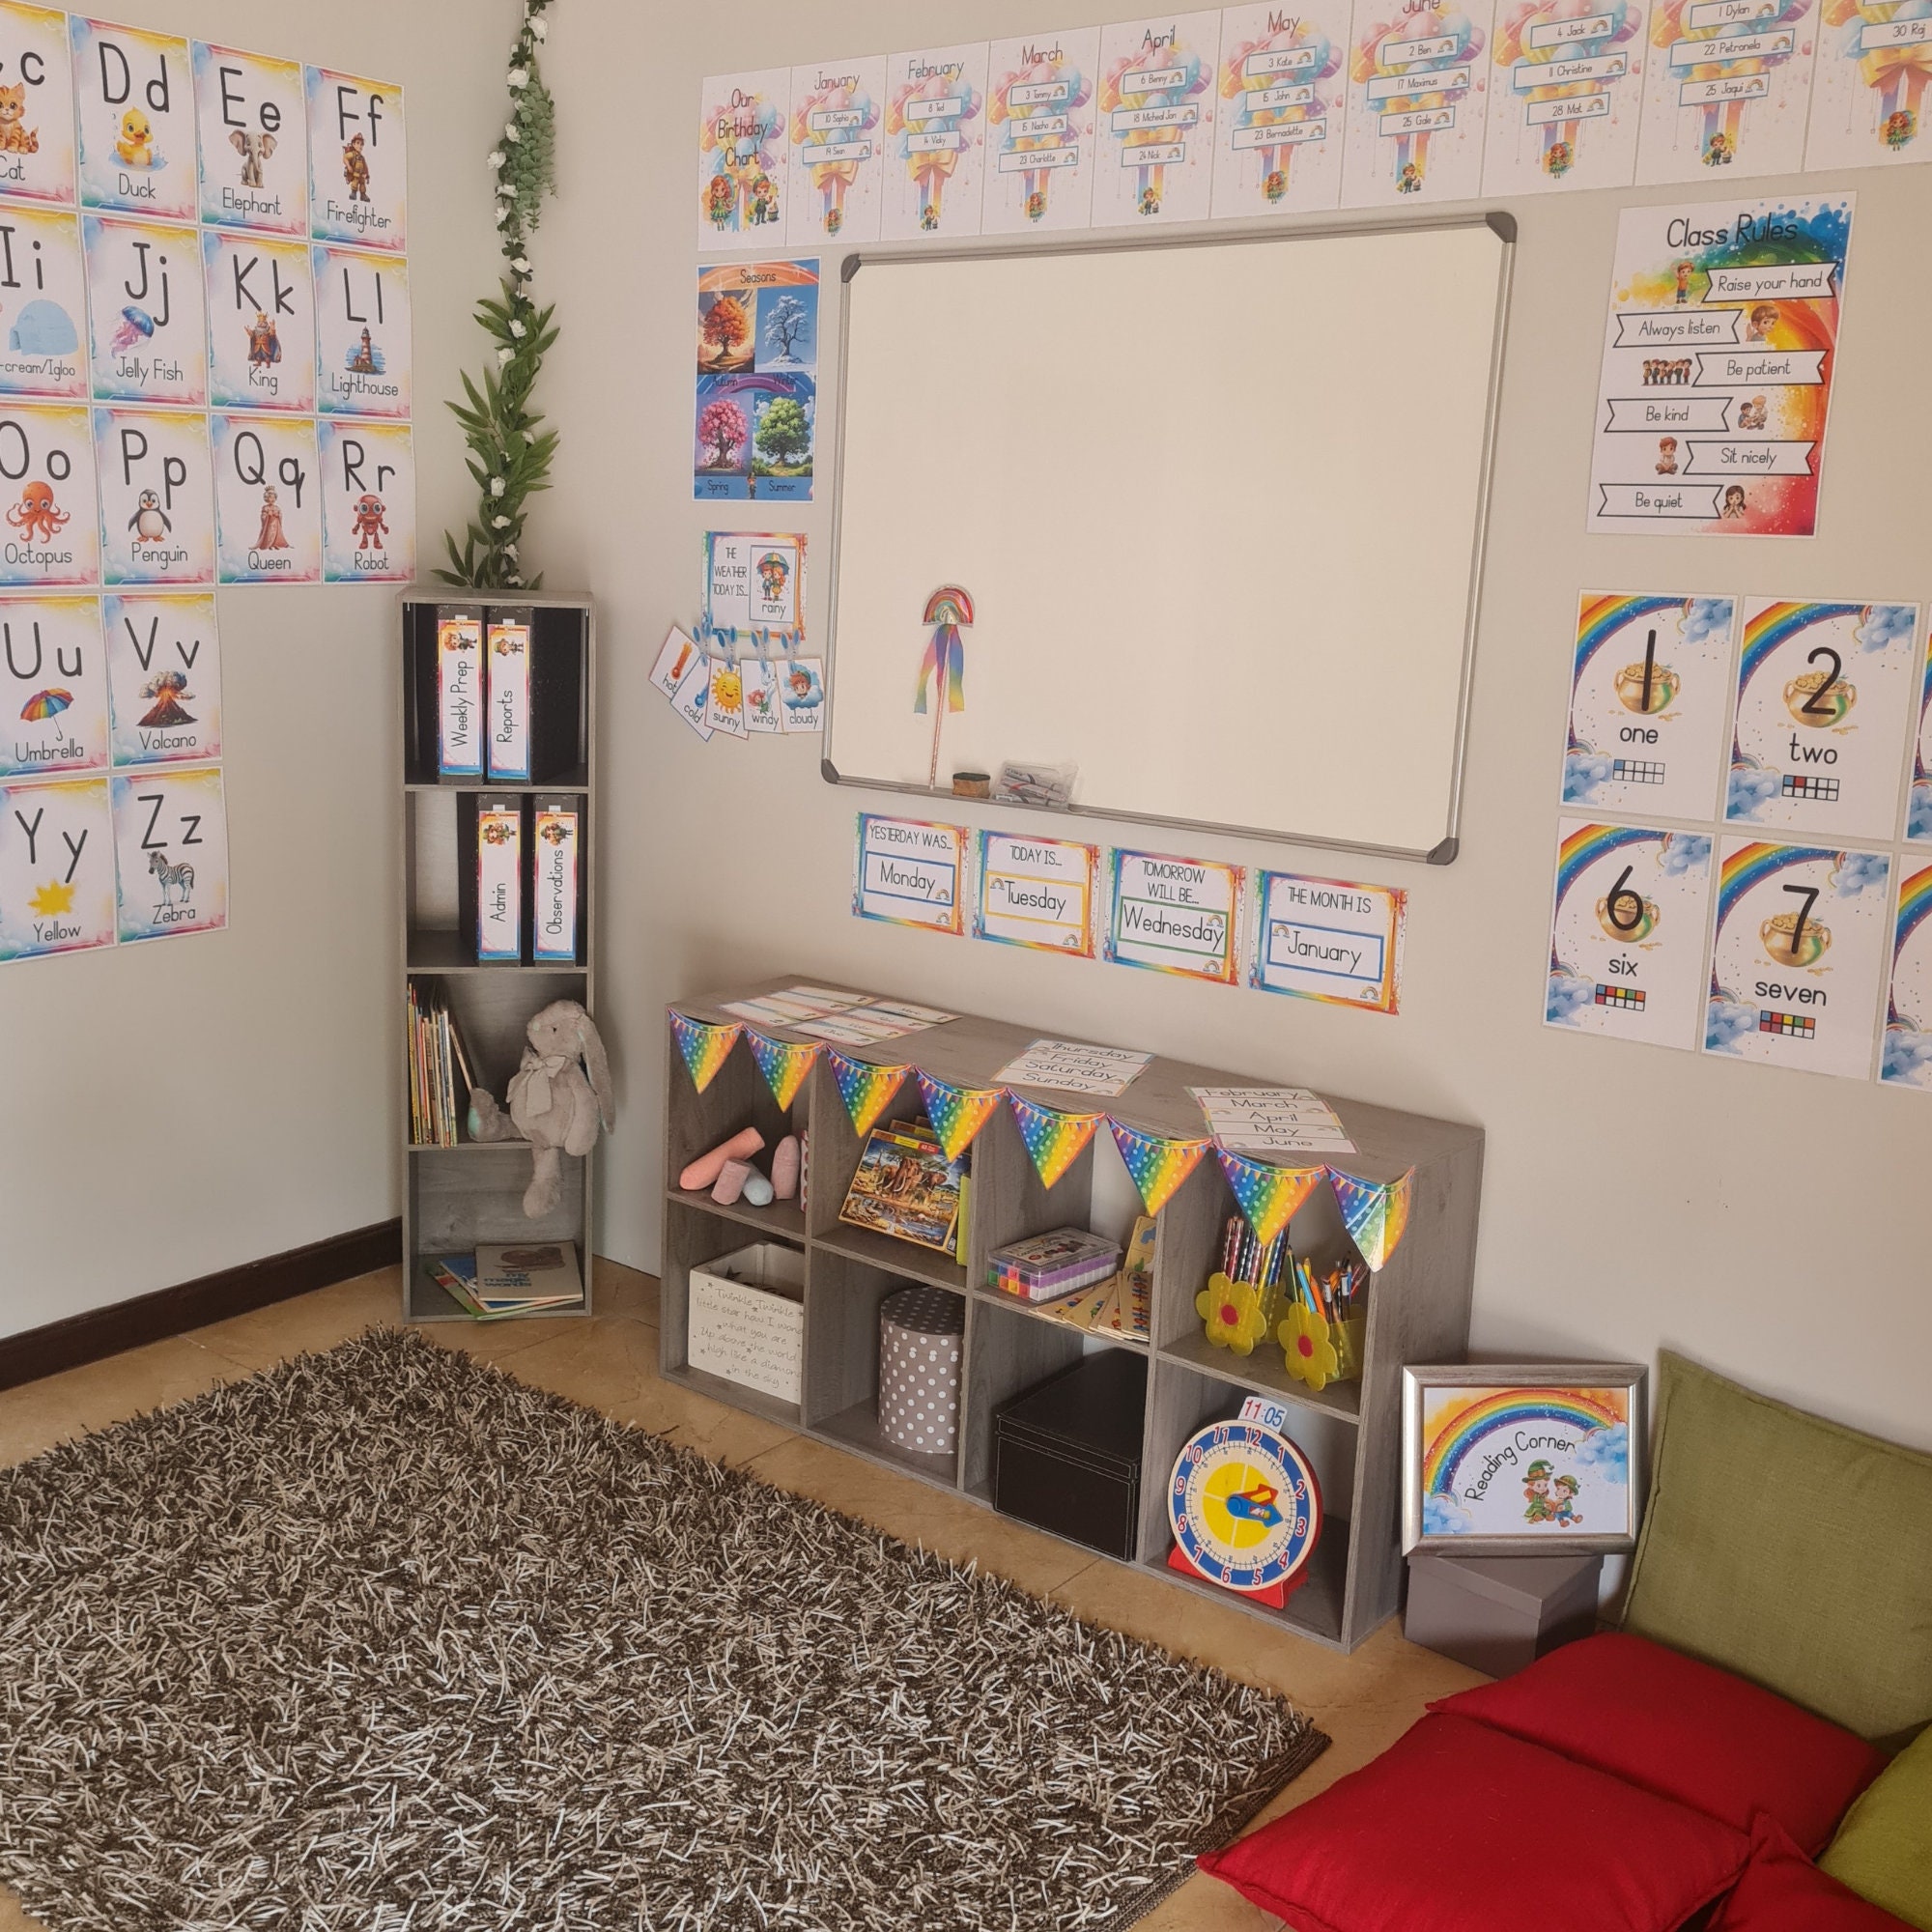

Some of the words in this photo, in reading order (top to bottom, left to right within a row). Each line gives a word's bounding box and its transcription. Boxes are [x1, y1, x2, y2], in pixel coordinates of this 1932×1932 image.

[1726, 3, 1750, 19] Dylan
[1267, 10, 1300, 38] May
[1567, 24, 1585, 37] Jack
[1892, 25, 1907, 39] 30
[1141, 24, 1176, 57] April
[1408, 45, 1415, 56] 2
[1417, 44, 1432, 55] Ben
[1704, 43, 1716, 55] 22
[1021, 41, 1063, 66] March
[1267, 58, 1274, 68] 3
[1276, 56, 1293, 67] Kate
[908, 59, 965, 81] February
[1140, 75, 1146, 85] 6
[1148, 73, 1168, 85] Benny
[1557, 64, 1593, 76] Christine
[814, 71, 860, 94] January
[1397, 79, 1405, 90] 17
[1407, 78, 1438, 88] Maximus
[1705, 84, 1717, 96] 25
[731, 88, 755, 109] Our
[1025, 90, 1031, 100] 3
[1274, 91, 1290, 100] John
[1552, 105, 1563, 116] 28
[718, 119, 768, 143] Birthday
[1403, 116, 1412, 127] 25
[1255, 129, 1264, 140] 23
[724, 146, 760, 167] Chart
[1019, 155, 1028, 165] 23
[118, 172, 156, 200] Duck
[222, 187, 282, 218] Elephant
[327, 200, 391, 233] Firefighter
[1666, 218, 1728, 247] Class
[1735, 213, 1798, 243] Rules
[740, 270, 777, 284] Seasons
[1718, 274, 1751, 292] Raise
[1754, 278, 1787, 297] your
[1790, 270, 1823, 288] hand
[1639, 321, 1685, 341] Always
[1689, 317, 1720, 335] listen
[116, 355, 149, 383] Jelly
[154, 358, 184, 382] Fish
[1727, 359, 1743, 376] Be
[1746, 361, 1792, 381] patient
[248, 366, 278, 395] King
[331, 372, 399, 401] Lighthouse
[1646, 406, 1662, 421] Be
[1664, 405, 1689, 421] kind
[1720, 447, 1738, 465] Sit
[1742, 447, 1777, 470] nicely
[707, 479, 728, 495] Spring
[768, 480, 795, 492] Summer
[1635, 492, 1651, 508] Be
[1654, 494, 1683, 514] quiet
[5, 543, 72, 572] Octopus
[131, 541, 188, 572] Penguin
[247, 551, 292, 571] Queen
[354, 552, 389, 570] Robot
[725, 547, 737, 559] THE
[715, 566, 747, 578] WEATHER
[712, 583, 735, 596] TODAY
[761, 604, 786, 619] rainy
[450, 661, 474, 696] Prep
[1641, 629, 1657, 712] 1
[1801, 646, 1842, 715] 2
[662, 673, 677, 695] hot
[450, 696, 475, 748] Weekly
[496, 690, 518, 744] Reports
[684, 703, 702, 724] cold
[713, 712, 741, 732] sunny
[752, 711, 780, 729] windy
[789, 709, 819, 728] cloudy
[139, 730, 197, 751] Volcano
[1619, 724, 1659, 745] one
[15, 739, 84, 763] Umbrella
[1790, 732, 1838, 766] two
[869, 824, 920, 845] YESTERDAY
[1010, 845, 1042, 864] TODAY
[880, 861, 936, 898] Monday
[1142, 860, 1206, 884] TOMORROW
[546, 849, 564, 935] Observations
[1005, 881, 1066, 920] Tuesday
[1148, 882, 1177, 902] WILL
[1288, 886, 1308, 905] THE
[1310, 891, 1353, 912] MONTH
[1355, 896, 1372, 914] IS
[1607, 865, 1644, 931] 6
[490, 882, 506, 923] Admin
[152, 904, 196, 924] Zebra
[1782, 884, 1820, 954] 7
[33, 922, 81, 943] Yellow
[1123, 904, 1224, 952] Wednesday
[1288, 930, 1362, 974] January
[1607, 952, 1639, 978] six
[1754, 980, 1827, 1007] seven
[1050, 1053, 1114, 1069] Friday
[1052, 1043, 1135, 1060] Thursday
[1025, 1062, 1117, 1081] Saturday
[1022, 1073, 1097, 1091] Sunday
[1206, 1089, 1298, 1099] February
[1231, 1099, 1298, 1109] March
[1249, 1112, 1298, 1123] April
[1254, 1124, 1299, 1136] May
[1263, 1137, 1313, 1147] June
[1213, 1426, 1230, 1445] 11
[1245, 1427, 1263, 1447] 12
[1185, 1444, 1203, 1464] 10
[1277, 1446, 1286, 1463] 1
[1464, 1446, 1519, 1502] Reading
[1515, 1431, 1577, 1453] Corner
[1176, 1477, 1184, 1494] 9
[1294, 1480, 1305, 1499] 2
[1178, 1515, 1186, 1534] 8
[1295, 1518, 1306, 1537] 3
[1194, 1547, 1203, 1563] 7
[1279, 1551, 1289, 1569] 4
[1221, 1566, 1231, 1584] 6
[1253, 1569, 1264, 1586] 5
